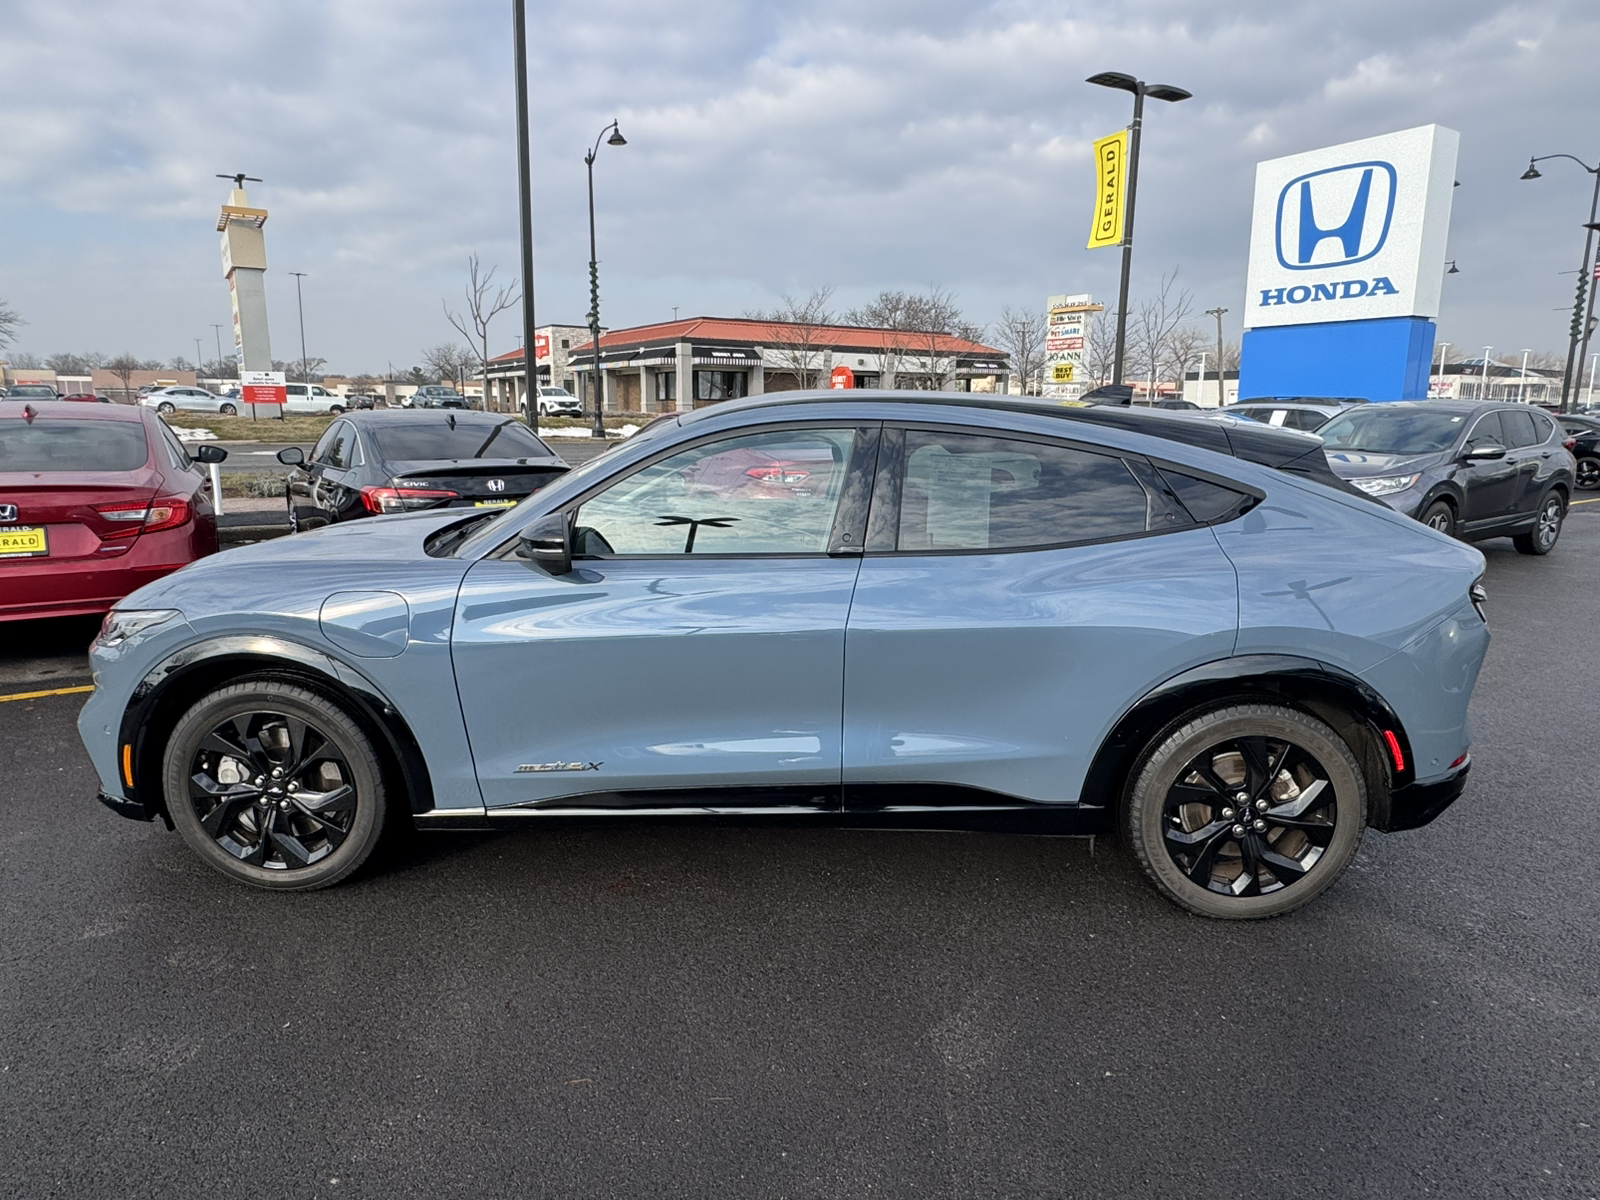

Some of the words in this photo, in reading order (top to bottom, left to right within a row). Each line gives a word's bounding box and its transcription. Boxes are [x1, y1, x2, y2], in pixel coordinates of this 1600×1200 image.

[1102, 150, 1116, 232] GERALD
[1259, 276, 1399, 307] HONDA
[0, 538, 36, 546] RALD
